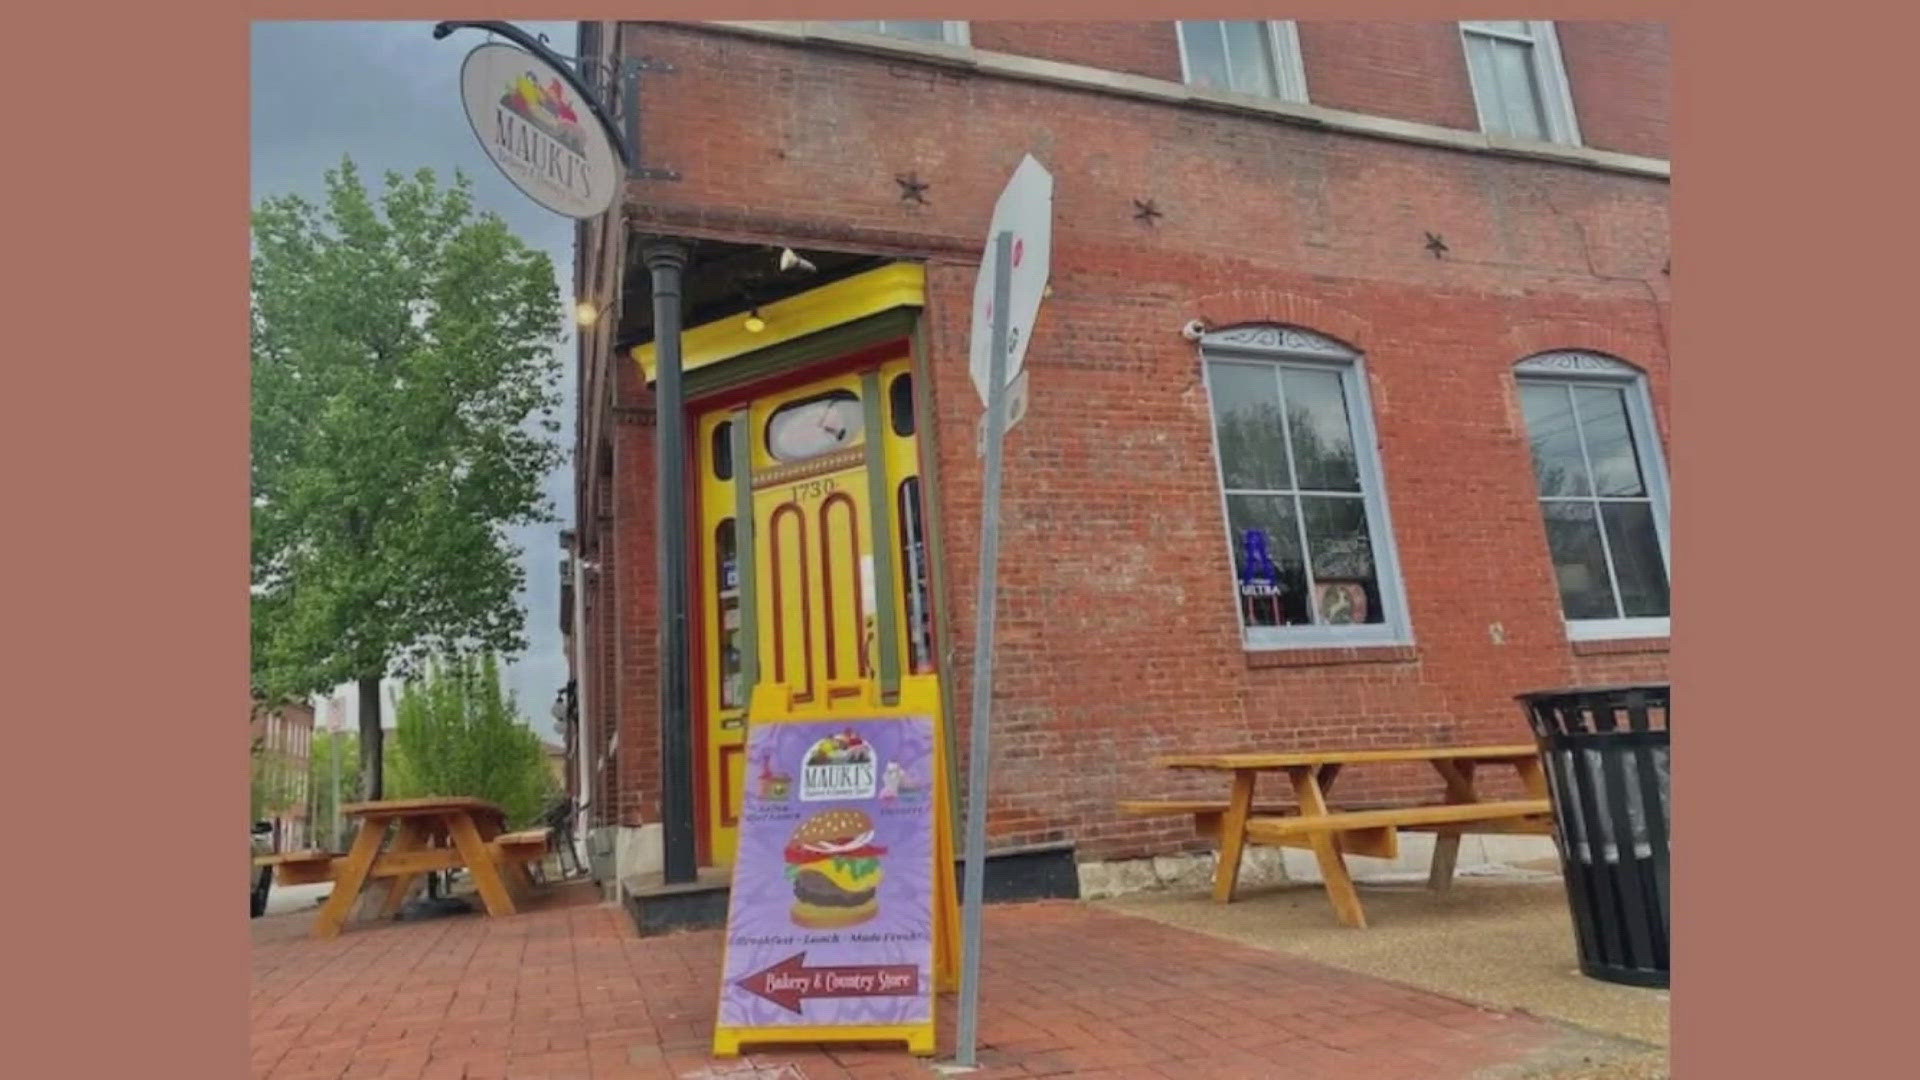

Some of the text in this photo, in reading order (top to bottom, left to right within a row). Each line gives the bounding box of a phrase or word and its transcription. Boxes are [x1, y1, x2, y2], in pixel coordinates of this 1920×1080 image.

[496, 108, 591, 199] MAUKI'S
[791, 478, 835, 503] 1730
[804, 763, 873, 789] MAUKI'S
[803, 932, 840, 944] Lunch
[765, 971, 810, 993] Bakery
[825, 971, 875, 992] Country
[877, 969, 911, 992] Store
